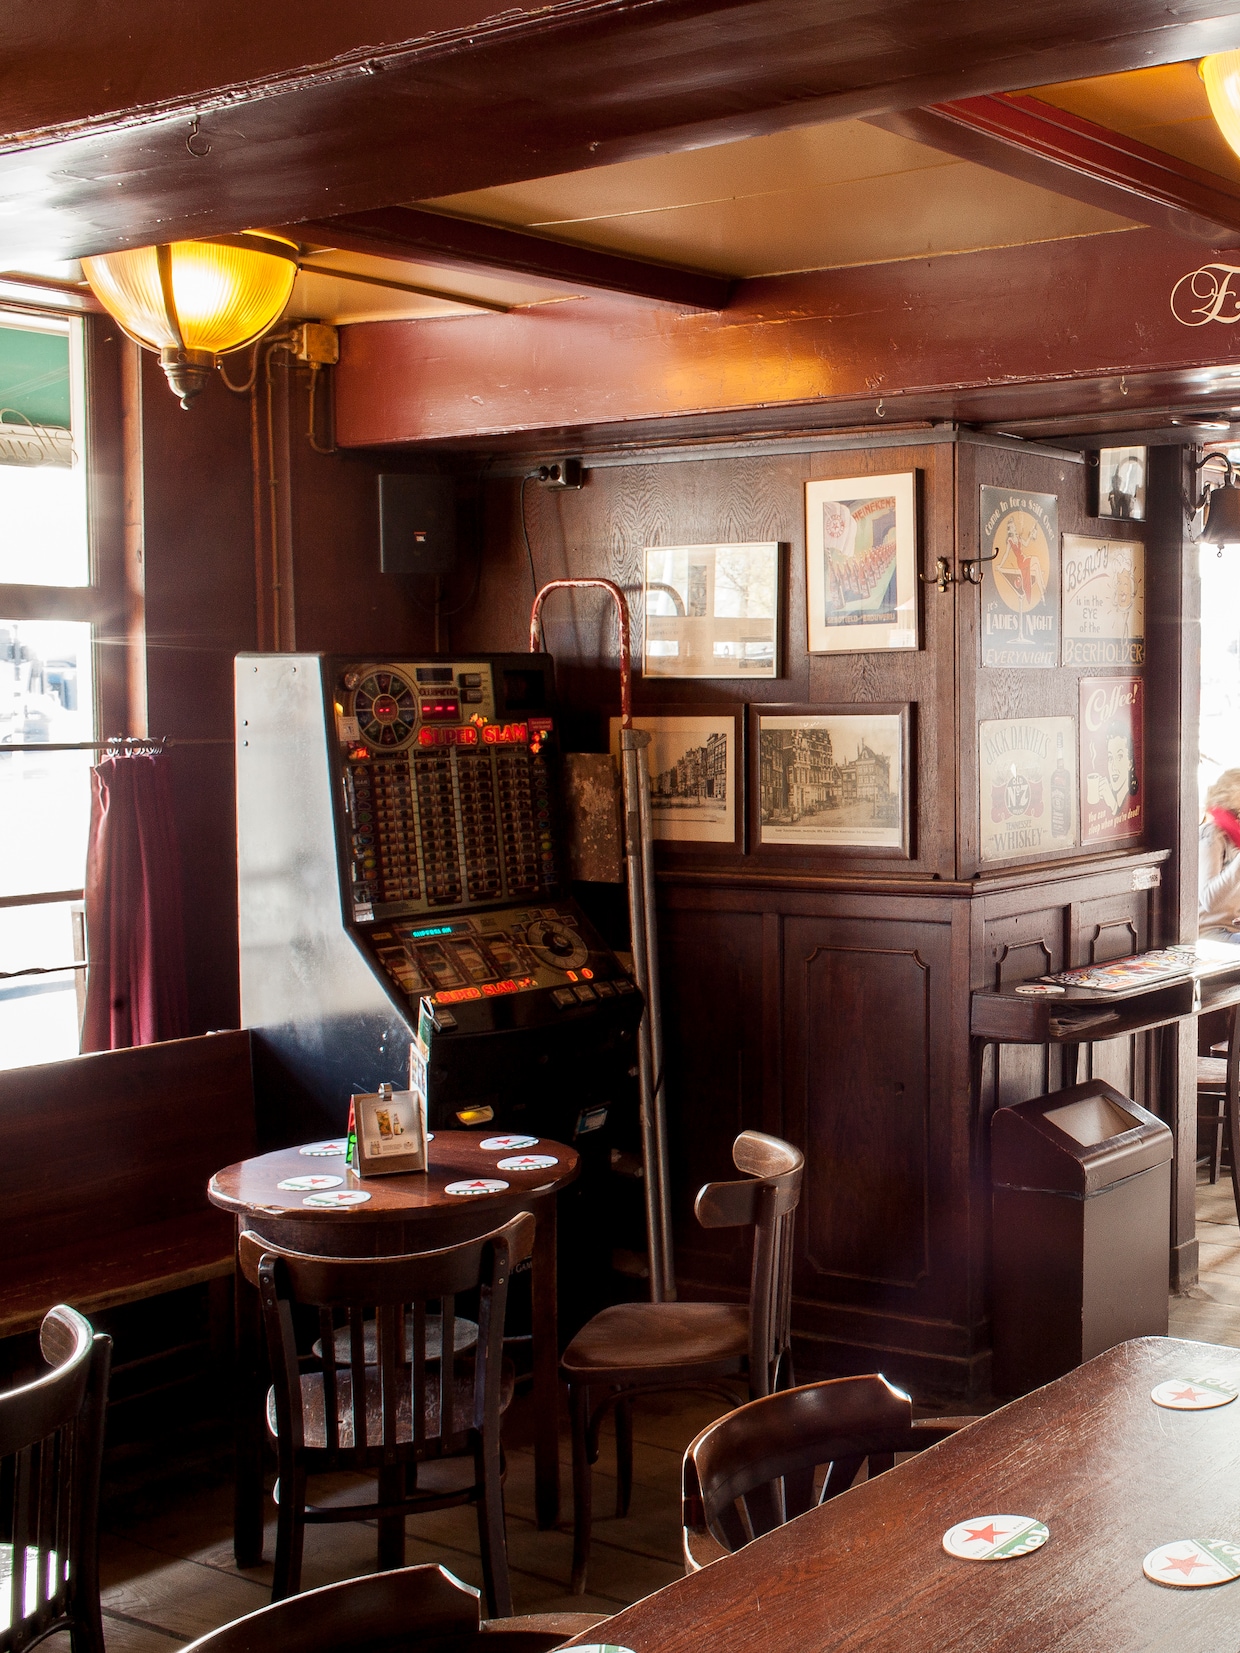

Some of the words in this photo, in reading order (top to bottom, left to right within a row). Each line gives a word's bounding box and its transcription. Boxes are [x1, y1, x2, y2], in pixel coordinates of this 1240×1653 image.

[1065, 543, 1110, 592] BEAUTY
[1076, 596, 1082, 606] is
[1084, 596, 1090, 606] in
[1092, 595, 1103, 606] the
[986, 613, 1018, 635] LADIES
[1026, 614, 1053, 636] NIGHT
[1079, 623, 1087, 633] of
[1088, 622, 1101, 633] the
[986, 649, 1054, 664] EVERYNIGHT
[1085, 684, 1139, 732] Coffee!
[418, 725, 478, 747] SUPER
[482, 723, 528, 744] SLAM
[986, 730, 1010, 765] JACK
[993, 828, 1044, 851] WHISKEY
[435, 987, 482, 1003] SUPER
[481, 980, 518, 996] SLAM
